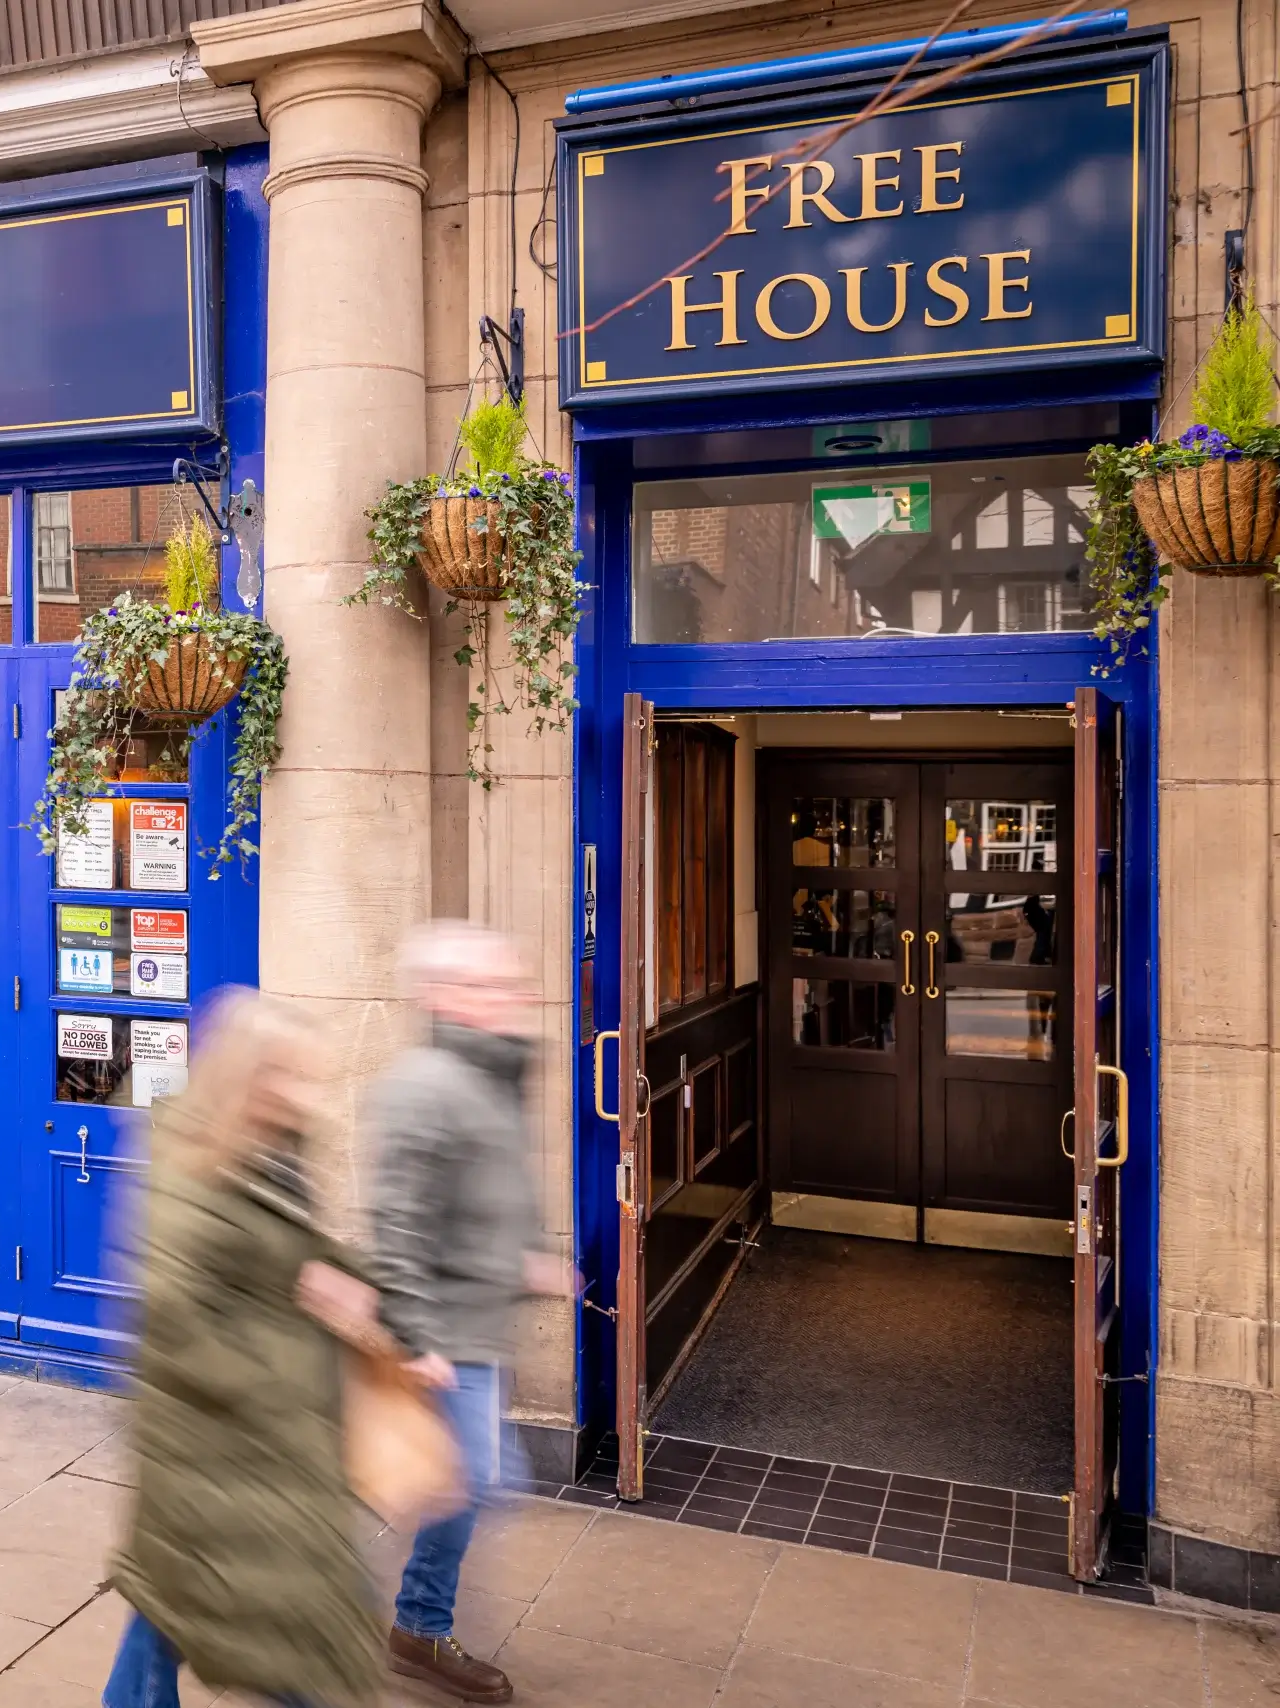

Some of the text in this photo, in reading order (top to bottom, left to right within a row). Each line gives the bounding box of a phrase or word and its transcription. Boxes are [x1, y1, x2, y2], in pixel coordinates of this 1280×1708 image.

[721, 141, 966, 235] FREE
[664, 249, 1033, 352] HOUSE
[135, 806, 176, 816] challenge
[136, 914, 155, 927] top
[72, 1021, 96, 1030] Sorry
[80, 1033, 106, 1041] DOGS
[63, 1039, 108, 1049] ALLOWED
